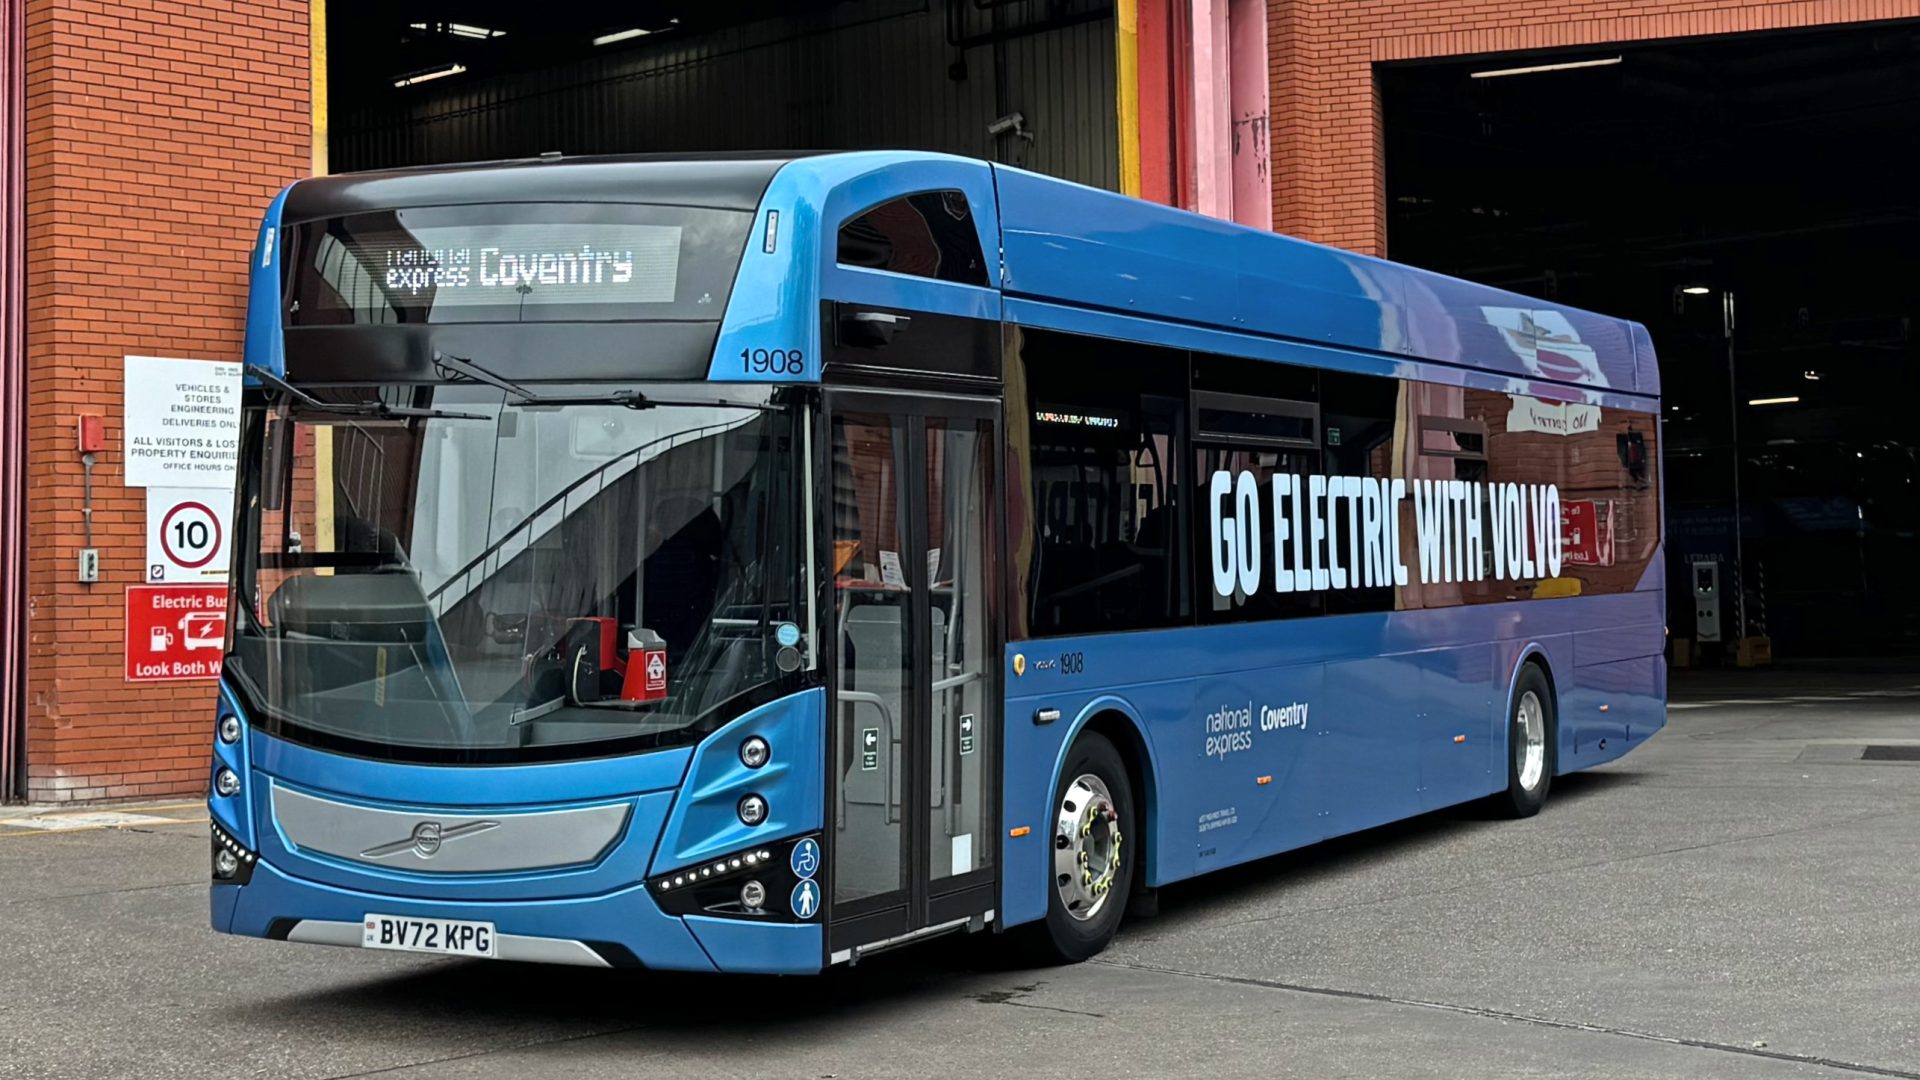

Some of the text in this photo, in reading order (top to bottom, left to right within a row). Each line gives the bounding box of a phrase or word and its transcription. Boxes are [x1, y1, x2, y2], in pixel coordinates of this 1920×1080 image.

[479, 244, 633, 287] Coventry
[386, 266, 471, 296] express
[740, 347, 804, 375] 1908
[175, 383, 230, 394] VEHICLES &
[184, 394, 222, 404] STORES
[170, 404, 235, 415] ENGINEERING
[162, 418, 239, 429] DELIVERIES ONL
[133, 437, 239, 449] ALL VISITORS & LOS
[131, 448, 237, 460] PROPERTY ENQUIRIE
[162, 462, 192, 471] OFFICE
[194, 463, 222, 471] HOURS
[174, 520, 209, 549] 10
[1210, 470, 1562, 597] GO ELECTRIC WITH VOLVO
[152, 594, 204, 609] Electric
[136, 661, 169, 677] Look
[173, 661, 206, 676] Both
[1060, 652, 1084, 675] 1908
[1206, 700, 1309, 734] national Coventry
[1205, 730, 1252, 762] express
[380, 919, 489, 952] BV72 KPG
